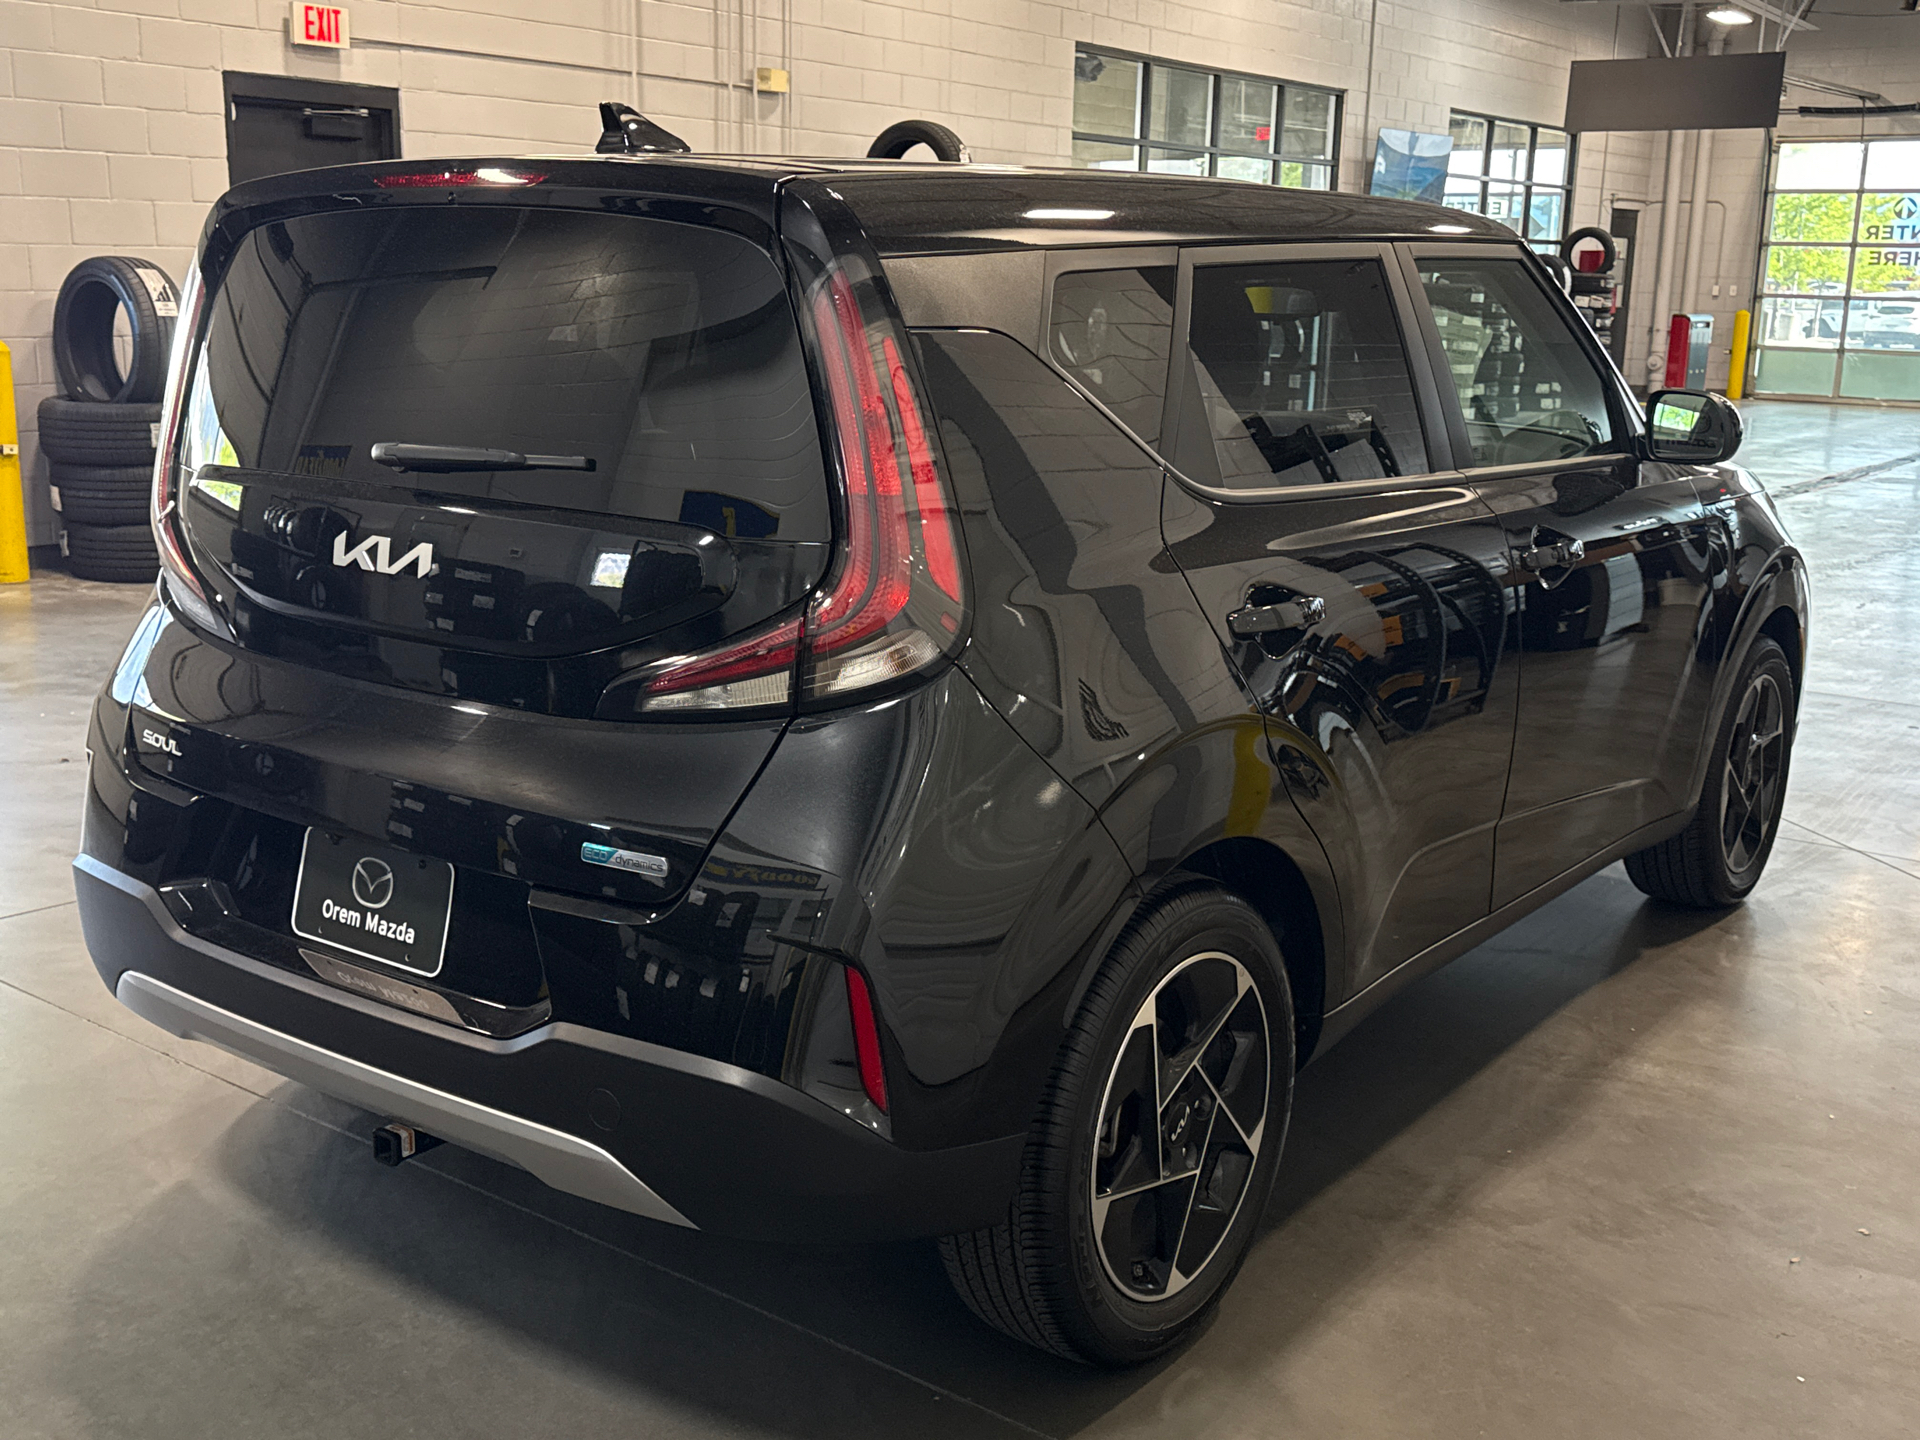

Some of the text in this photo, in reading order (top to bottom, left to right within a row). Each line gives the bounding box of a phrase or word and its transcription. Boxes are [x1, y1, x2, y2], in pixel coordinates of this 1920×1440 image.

[304, 5, 341, 43] EXIT
[333, 530, 433, 579] KIA
[142, 729, 182, 757] SOUL
[584, 848, 664, 872] ECO dynamics
[322, 899, 415, 945] Orem Mazda
